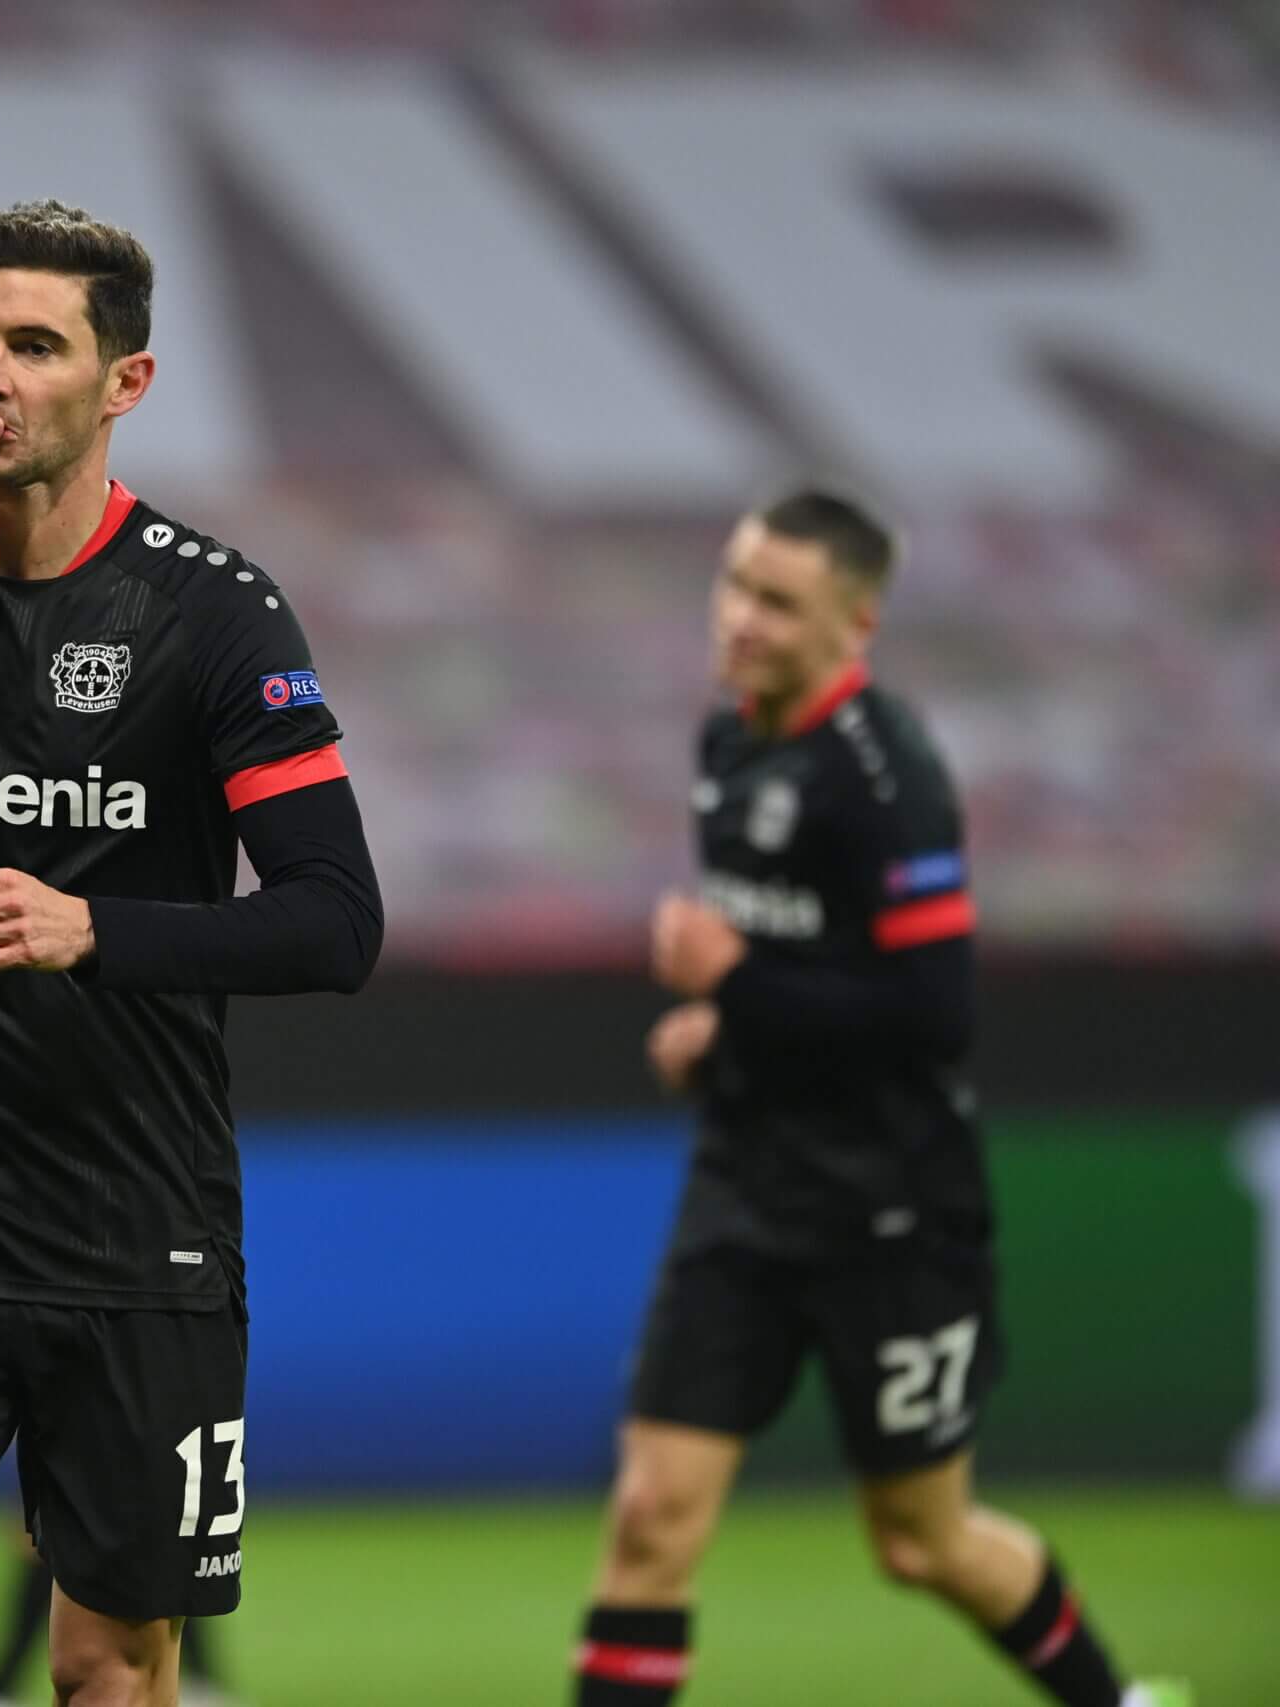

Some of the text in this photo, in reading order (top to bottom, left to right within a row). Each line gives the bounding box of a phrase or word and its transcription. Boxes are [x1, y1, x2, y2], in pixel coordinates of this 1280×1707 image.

[85, 647, 106, 657] 1904
[75, 674, 111, 683] BAYER
[291, 679, 321, 697] RES
[61, 695, 117, 710] Leverkusen
[876, 1316, 982, 1435] 27
[175, 1416, 245, 1537] 13
[194, 1550, 242, 1578] JAKO
